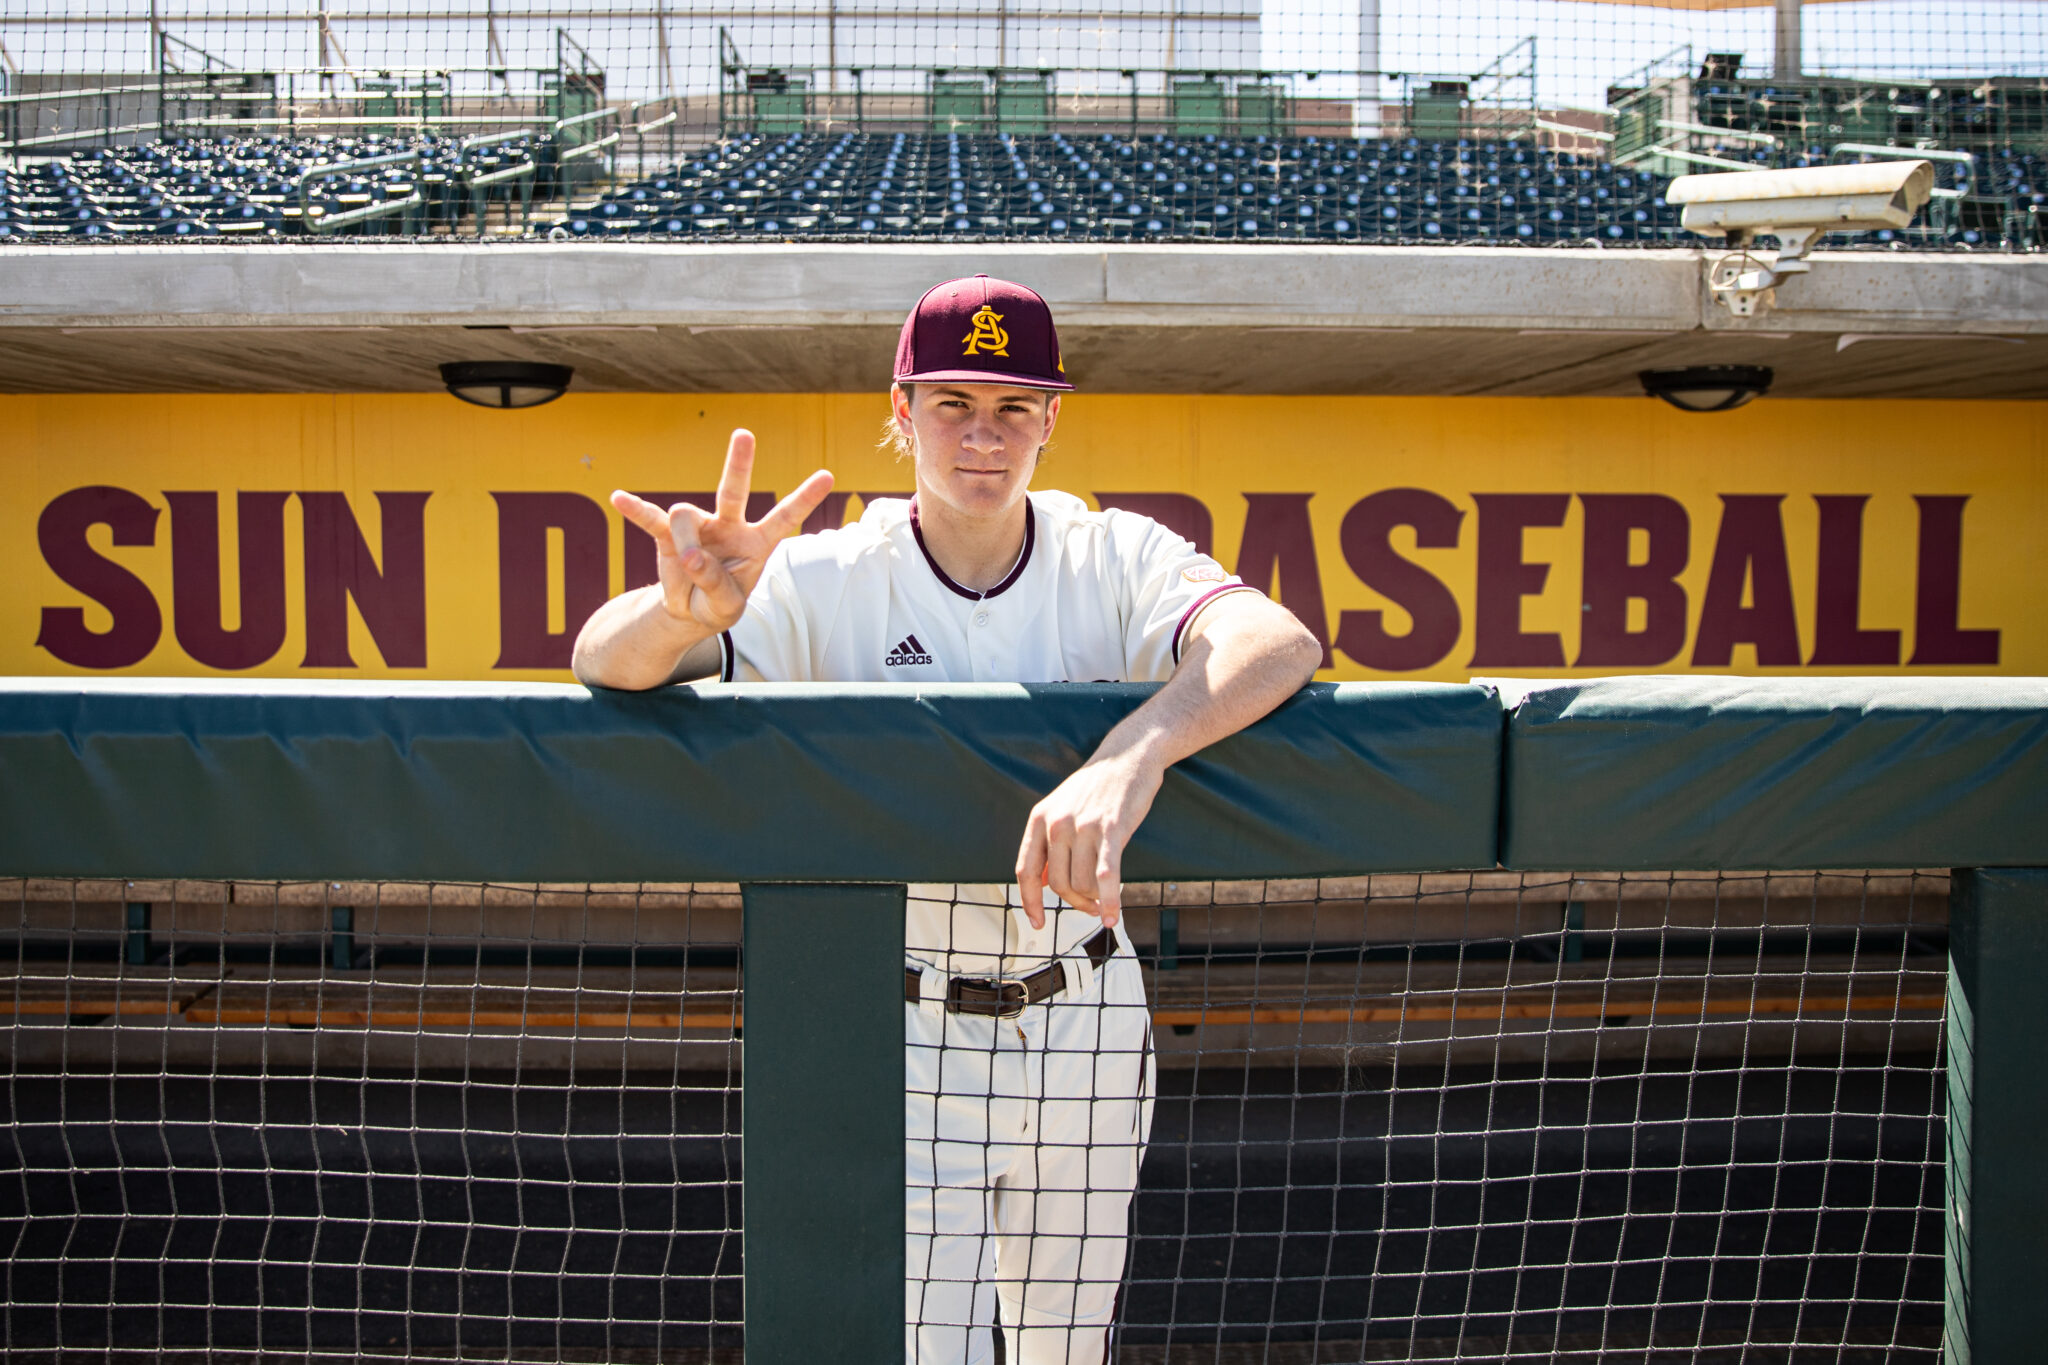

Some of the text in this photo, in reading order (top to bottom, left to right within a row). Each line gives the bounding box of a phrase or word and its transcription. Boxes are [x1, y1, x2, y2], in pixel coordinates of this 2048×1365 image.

[34, 485, 434, 670] SUN
[1091, 483, 2001, 671] ASEBALL
[885, 652, 933, 667] adidas
